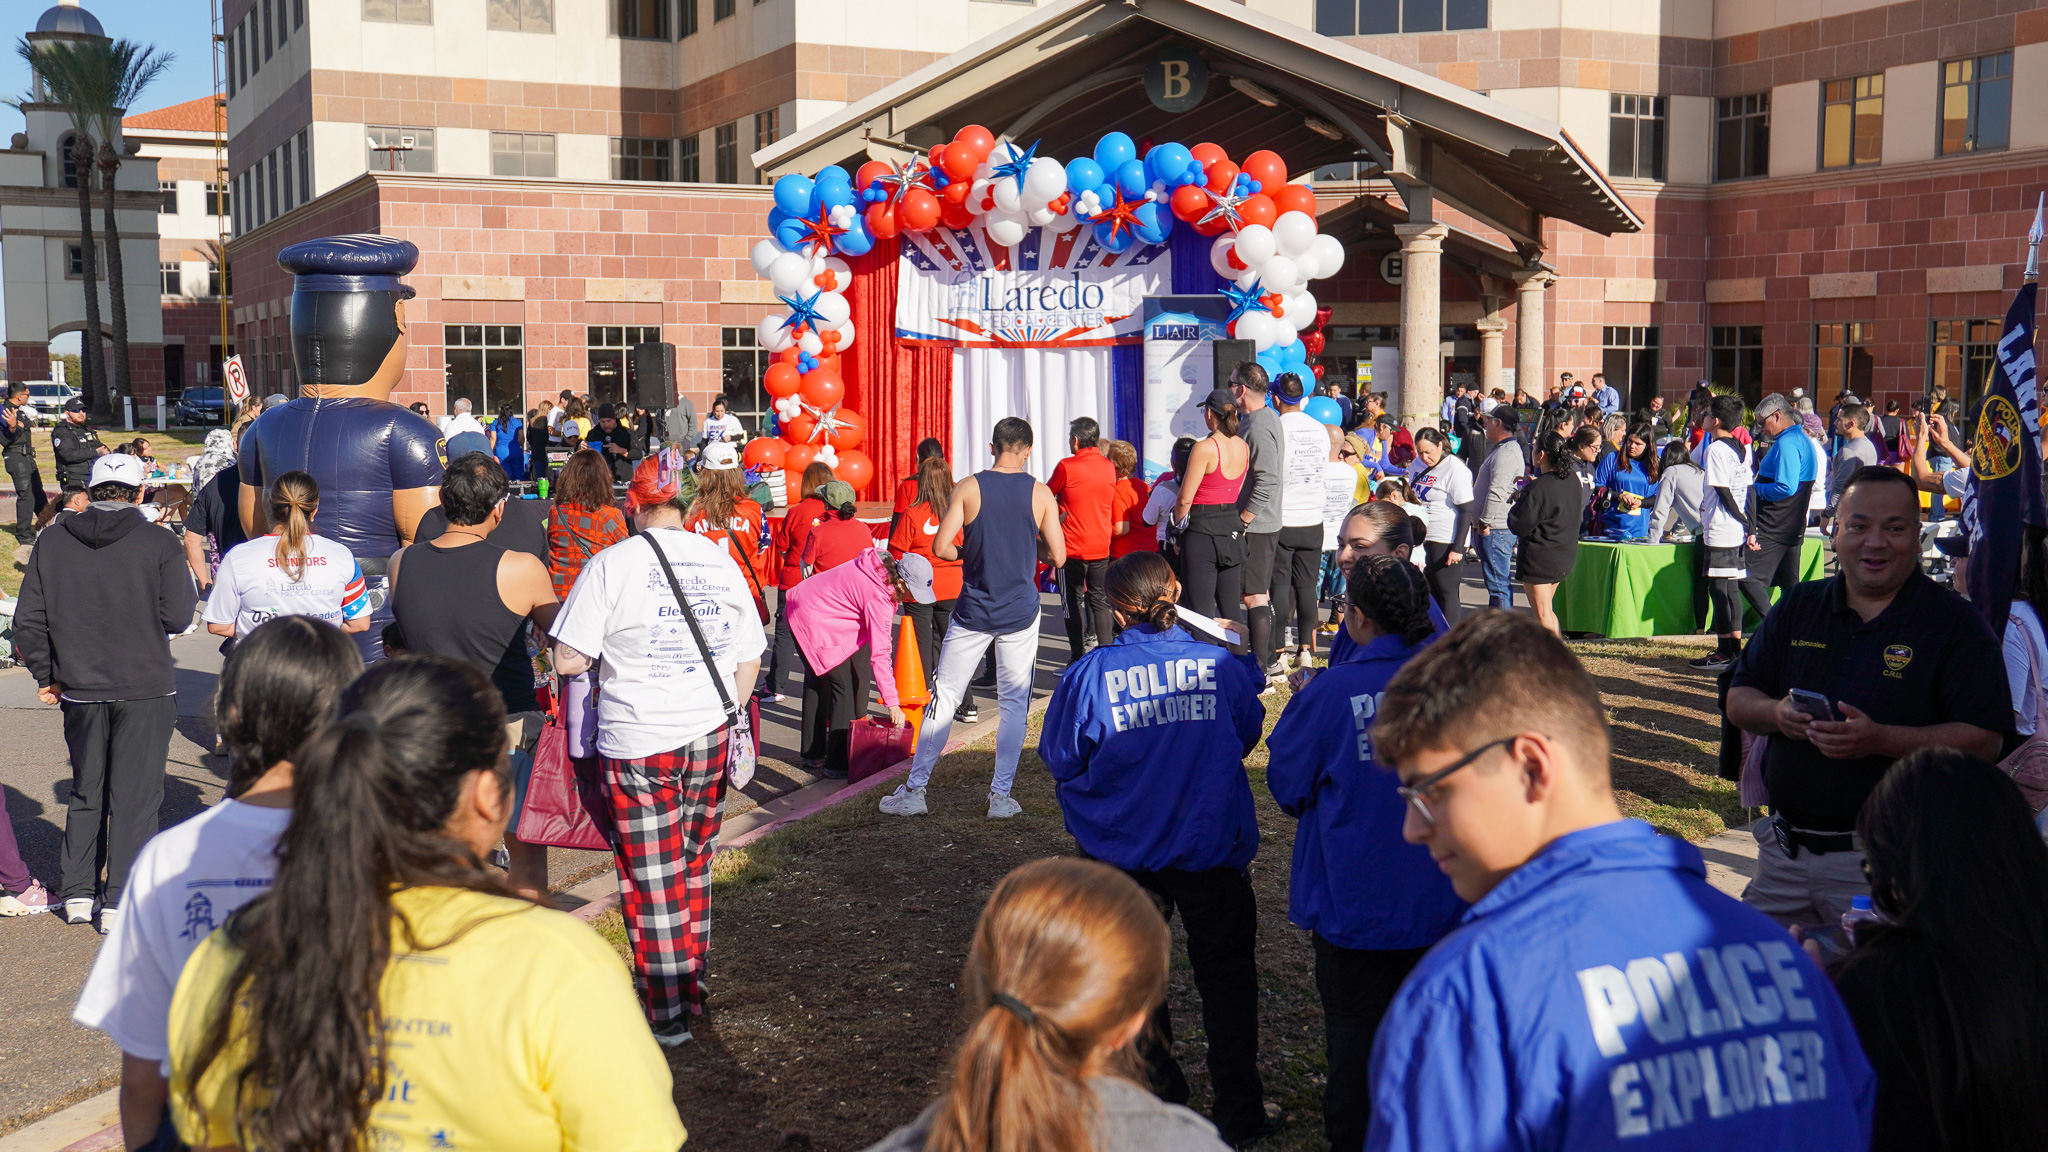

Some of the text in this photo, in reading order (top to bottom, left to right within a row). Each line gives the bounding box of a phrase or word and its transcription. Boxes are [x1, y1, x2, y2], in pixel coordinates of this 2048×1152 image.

[1160, 60, 1191, 99] B
[982, 271, 1104, 312] Laredo
[981, 312, 1106, 329] MEDICAL CENTER
[1155, 326, 1197, 339] LAR
[1995, 402, 2019, 446] POLICE
[268, 557, 327, 567] SONORS
[281, 582, 312, 591] Laredo
[1104, 658, 1217, 703] POLICE
[1111, 694, 1216, 733] EXPLORER
[1576, 940, 1817, 1058] POLICE
[1608, 1031, 1827, 1138] EXPLORER
